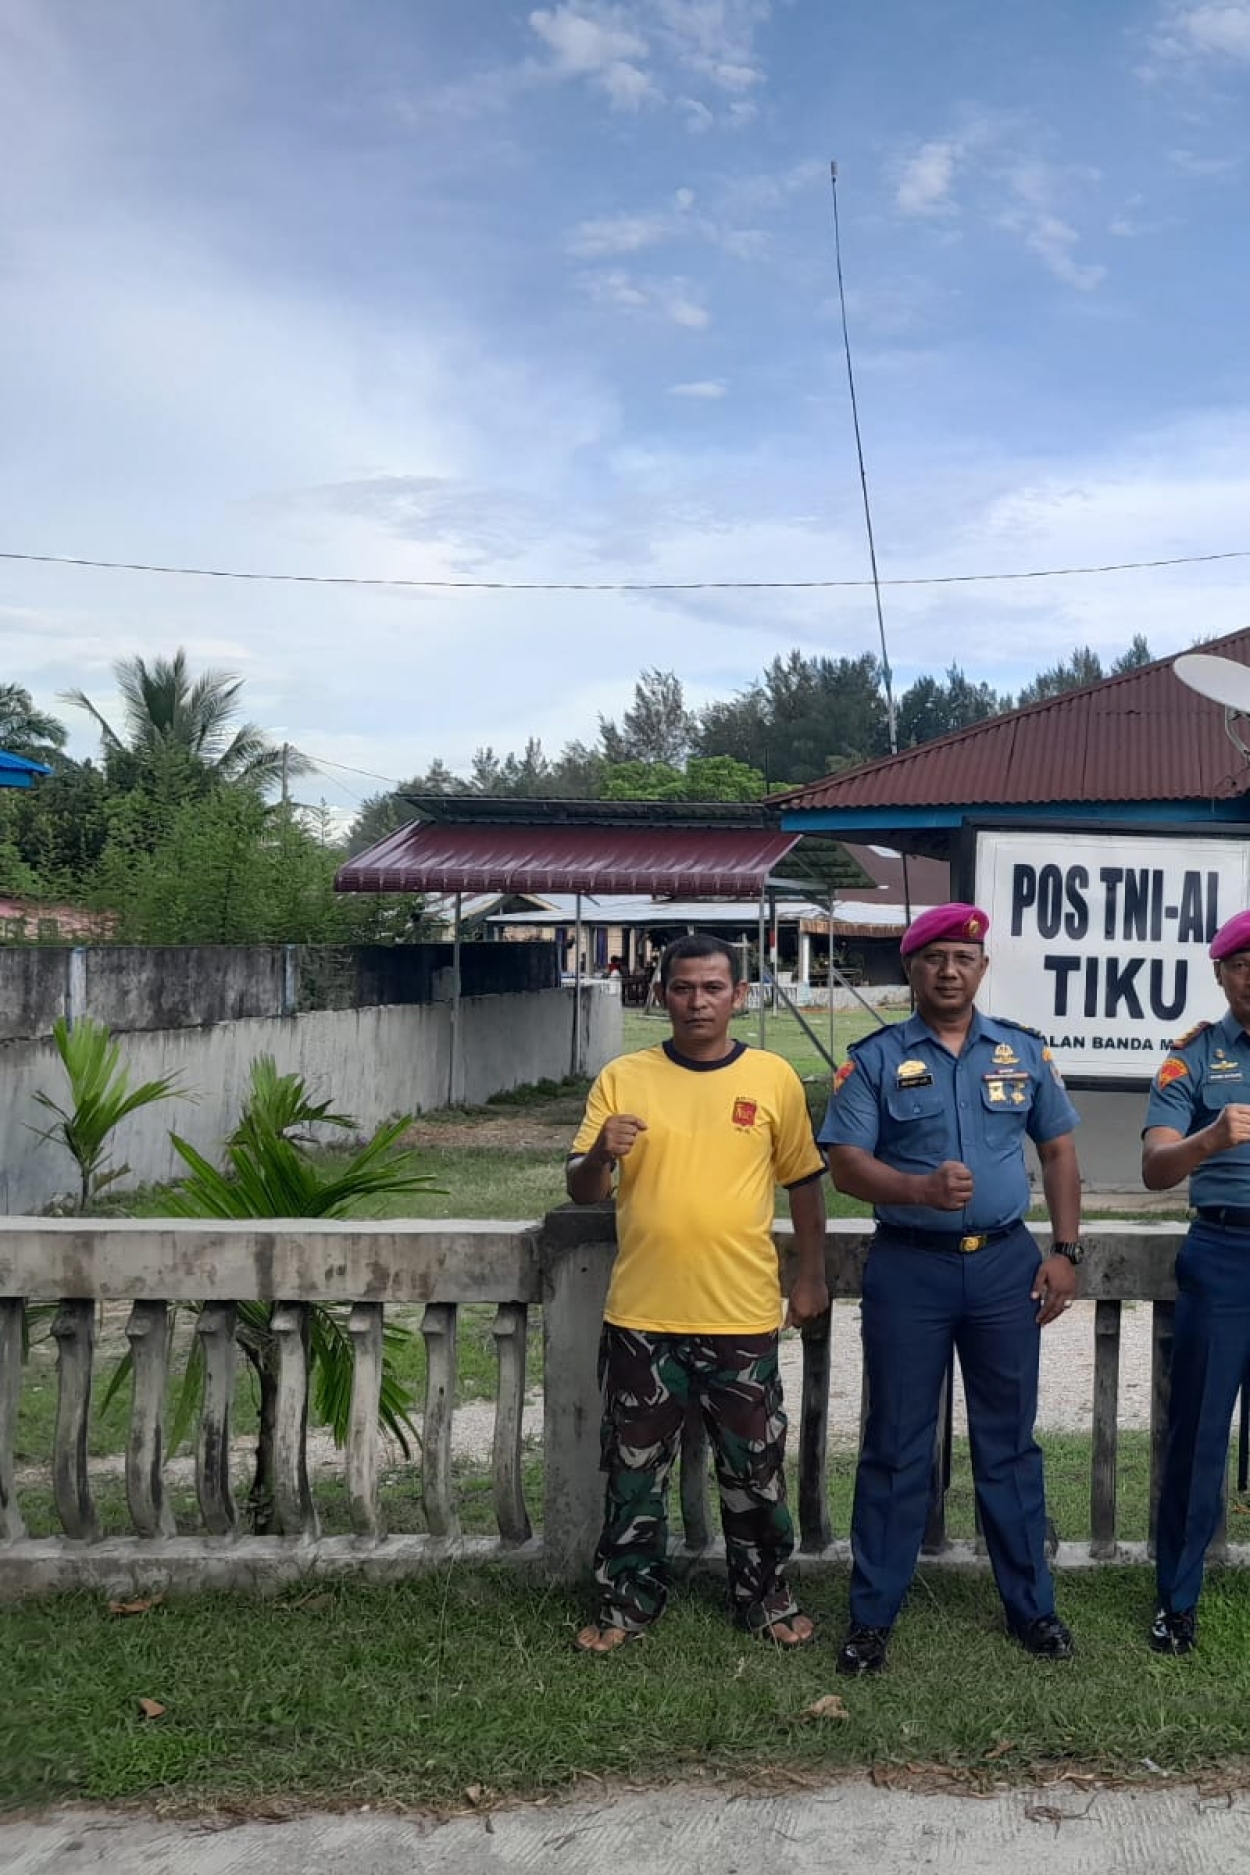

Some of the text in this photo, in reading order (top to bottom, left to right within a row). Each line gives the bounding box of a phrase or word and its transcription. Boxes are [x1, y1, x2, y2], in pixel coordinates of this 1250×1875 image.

[1011, 863, 1089, 940] POS
[1044, 955, 1188, 1021] TIKU
[1092, 1036, 1154, 1050] BANDA
